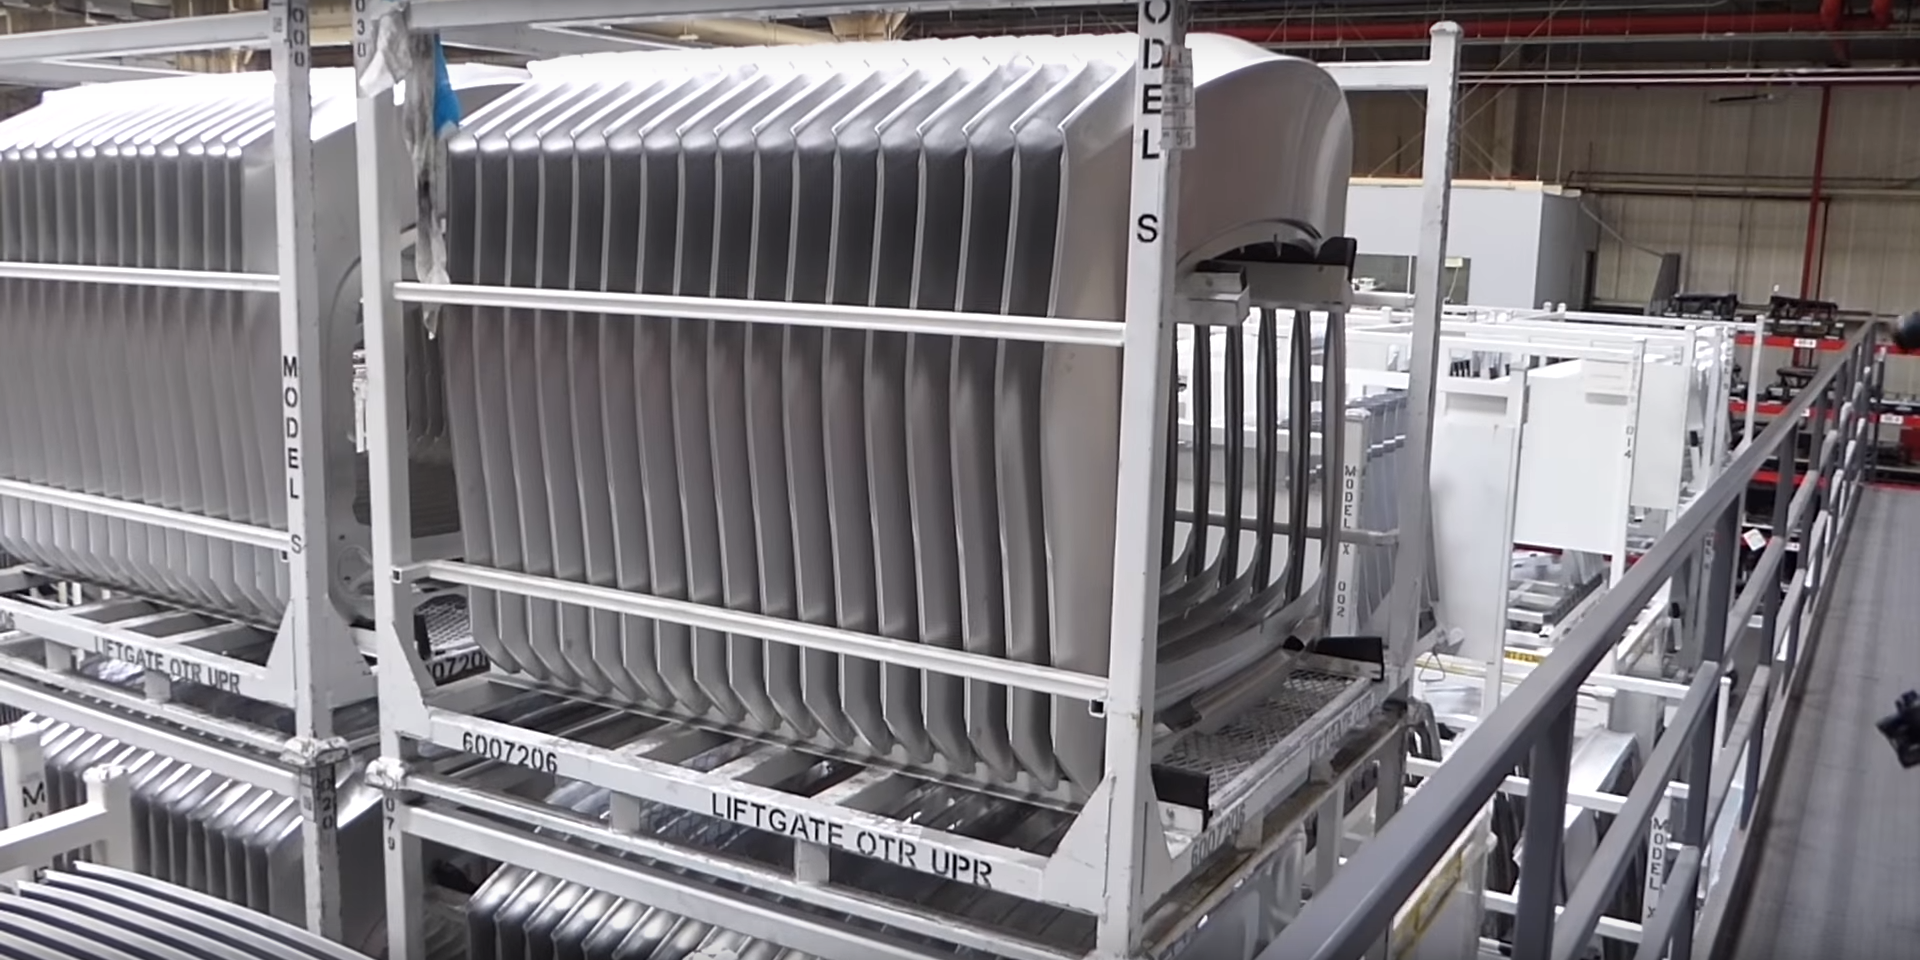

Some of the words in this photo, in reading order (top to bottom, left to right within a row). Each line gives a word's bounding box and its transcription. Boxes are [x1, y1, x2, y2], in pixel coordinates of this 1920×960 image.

[1137, 213, 1158, 243] S
[283, 355, 299, 499] MODEL
[291, 534, 303, 554] S
[1344, 465, 1356, 529] MODEL
[1342, 544, 1350, 555] X
[1337, 581, 1346, 618] 002
[94, 636, 163, 671] LIFTGATE
[208, 667, 241, 695] UPR
[463, 731, 557, 775] 6007206
[711, 793, 843, 849] LIFTGATE
[856, 831, 917, 868] OTR
[931, 848, 992, 889] UPR
[1649, 817, 1668, 890] MODEL
[1647, 906, 1656, 918] X
